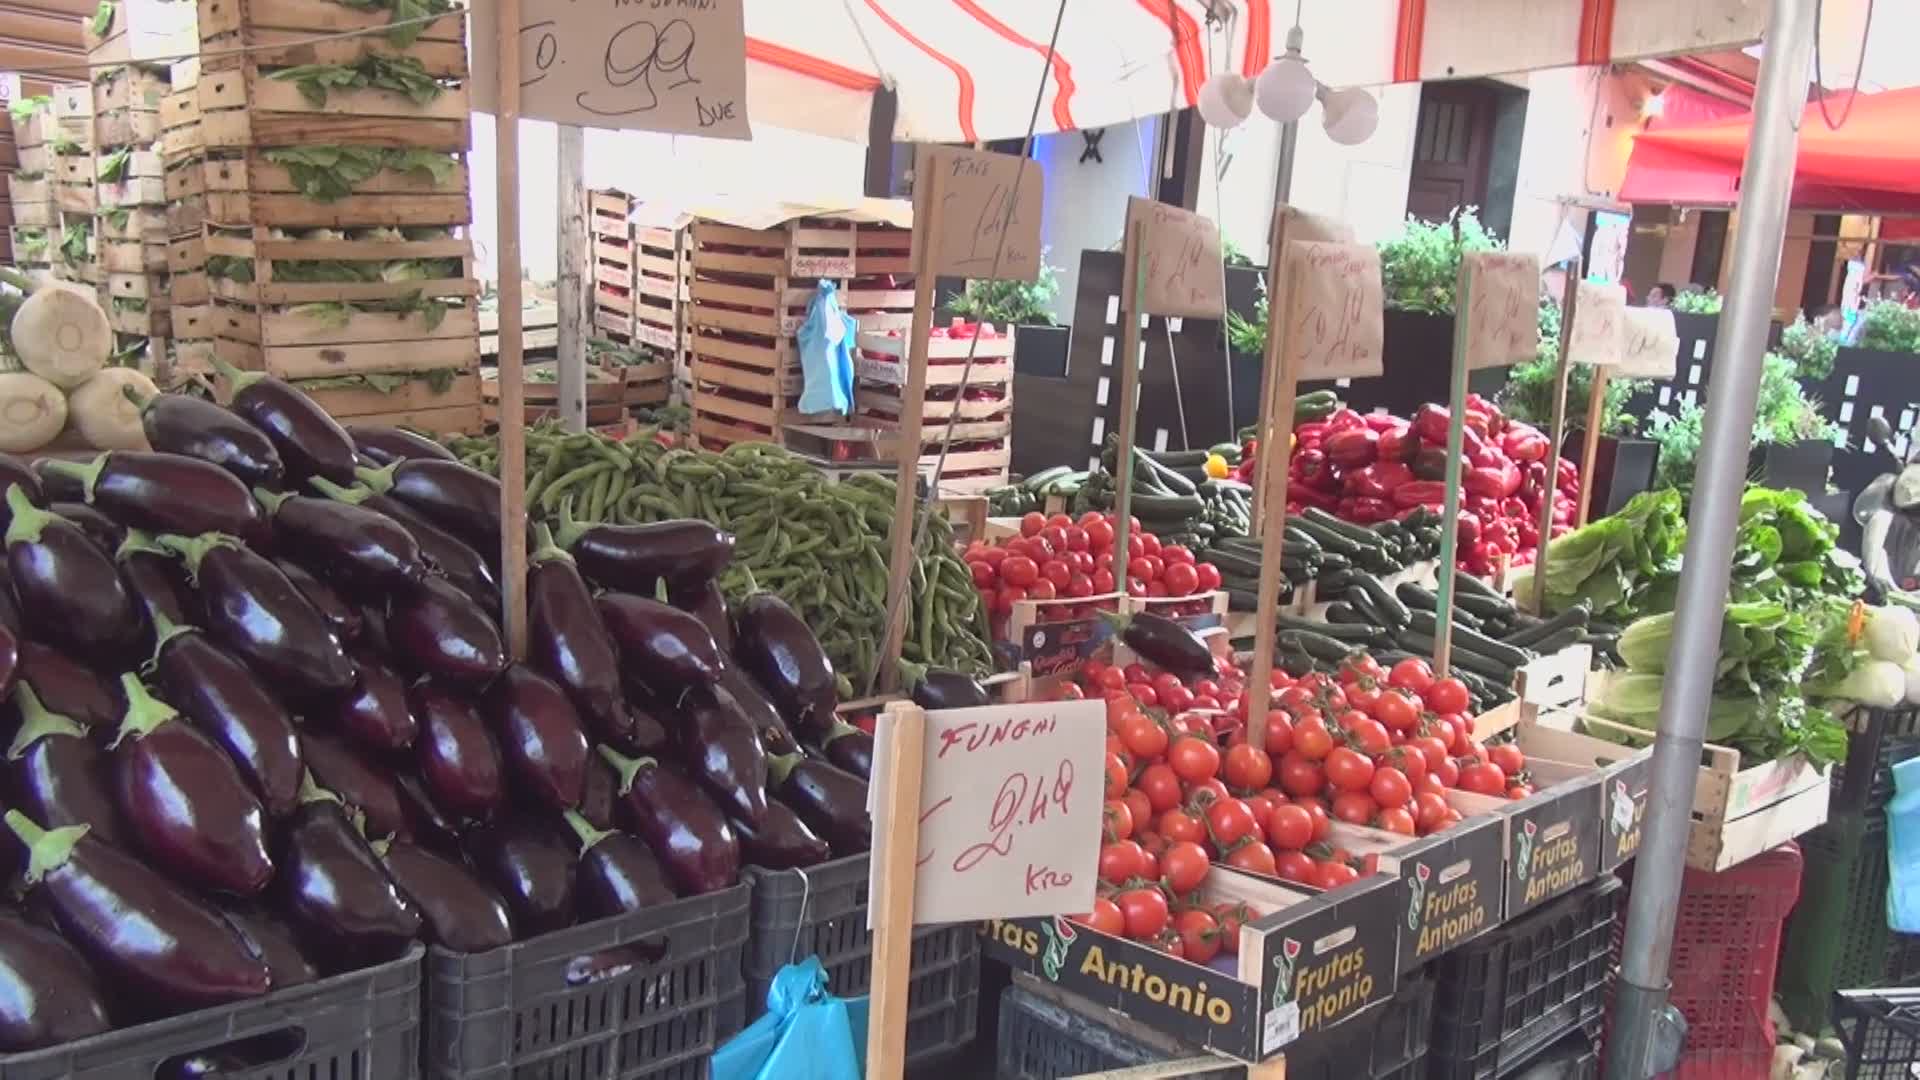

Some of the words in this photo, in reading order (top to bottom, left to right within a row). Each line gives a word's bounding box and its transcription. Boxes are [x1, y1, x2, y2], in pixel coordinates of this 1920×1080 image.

[696, 97, 736, 126] DUE
[1531, 835, 1577, 873] Frutas
[1425, 880, 1477, 921] Frutas
[1524, 859, 1583, 904] Antonio
[1416, 904, 1484, 957] Antonio
[1079, 945, 1232, 1025] Antonio
[1295, 947, 1364, 1002] Frutas
[1299, 972, 1373, 1032] ntonio
